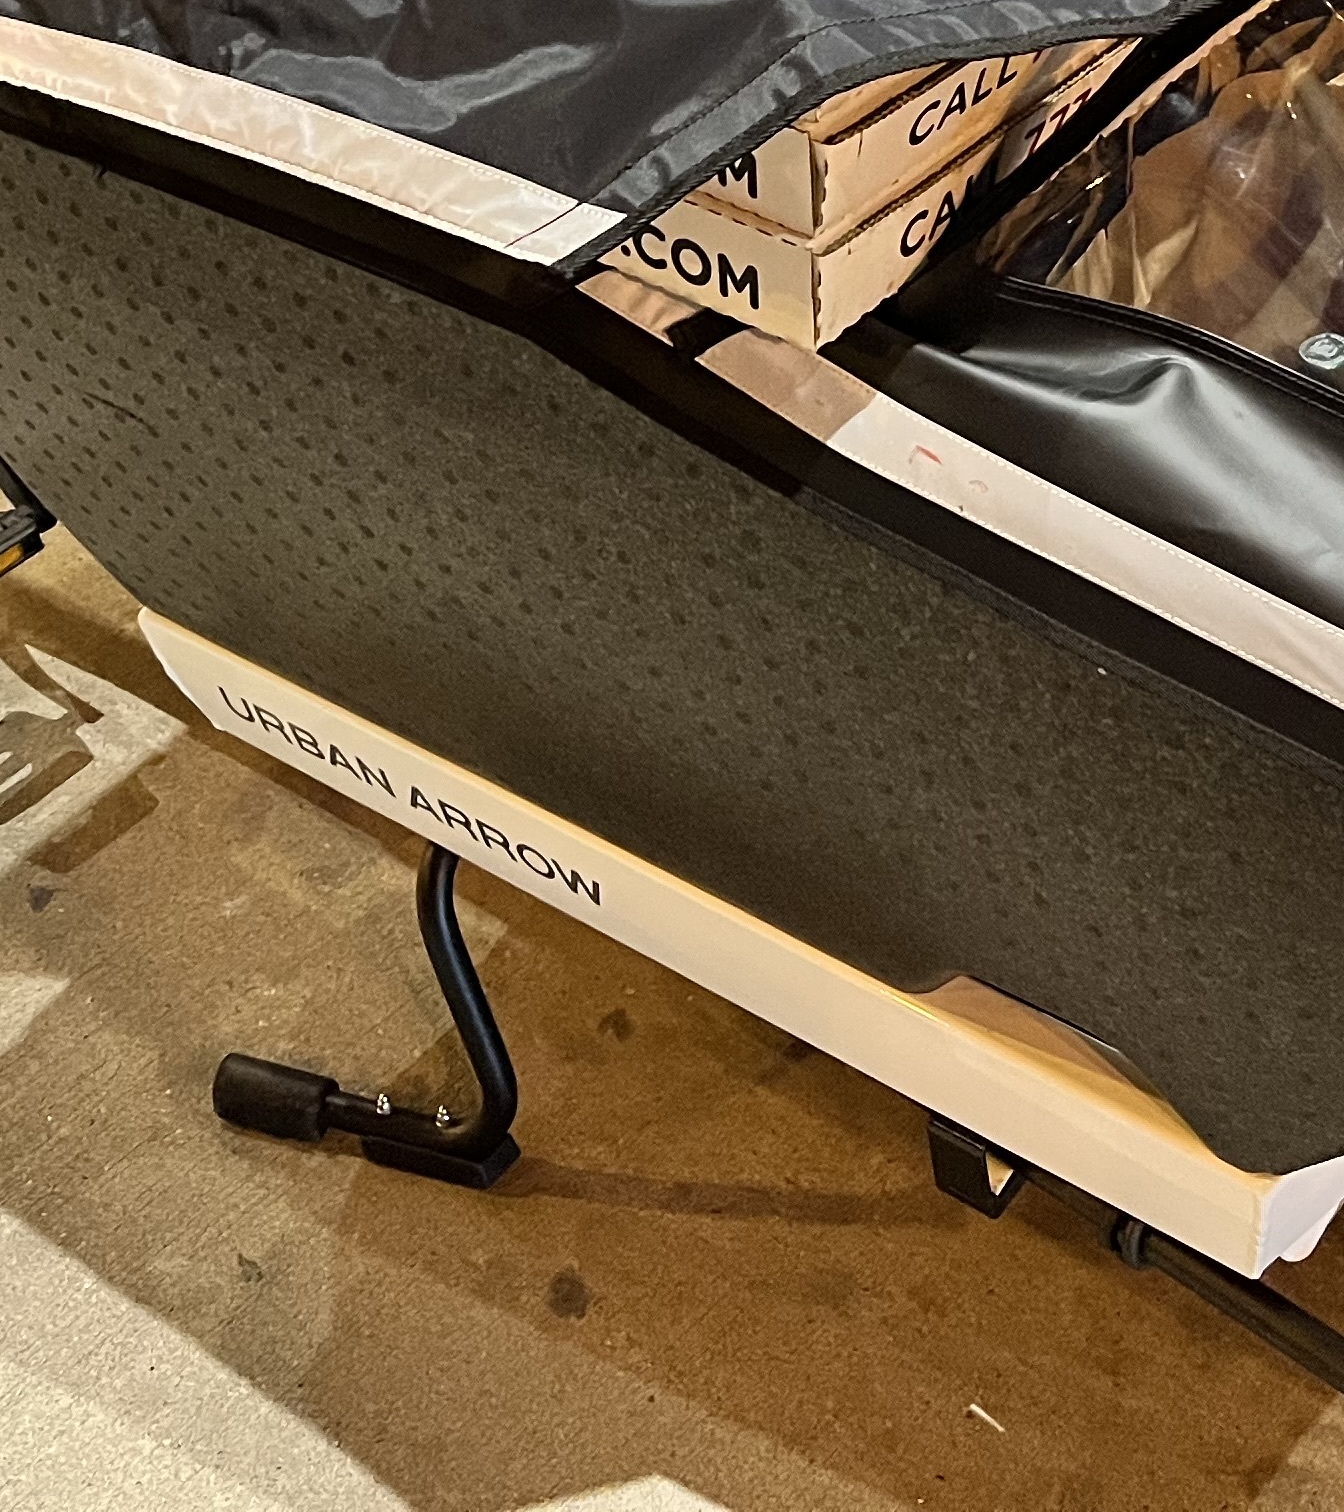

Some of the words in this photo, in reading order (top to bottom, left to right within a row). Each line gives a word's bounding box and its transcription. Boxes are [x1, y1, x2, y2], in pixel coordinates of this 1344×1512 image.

[908, 55, 1018, 146] CALL
[218, 685, 397, 798] URBAN
[409, 785, 602, 907] ARROW
